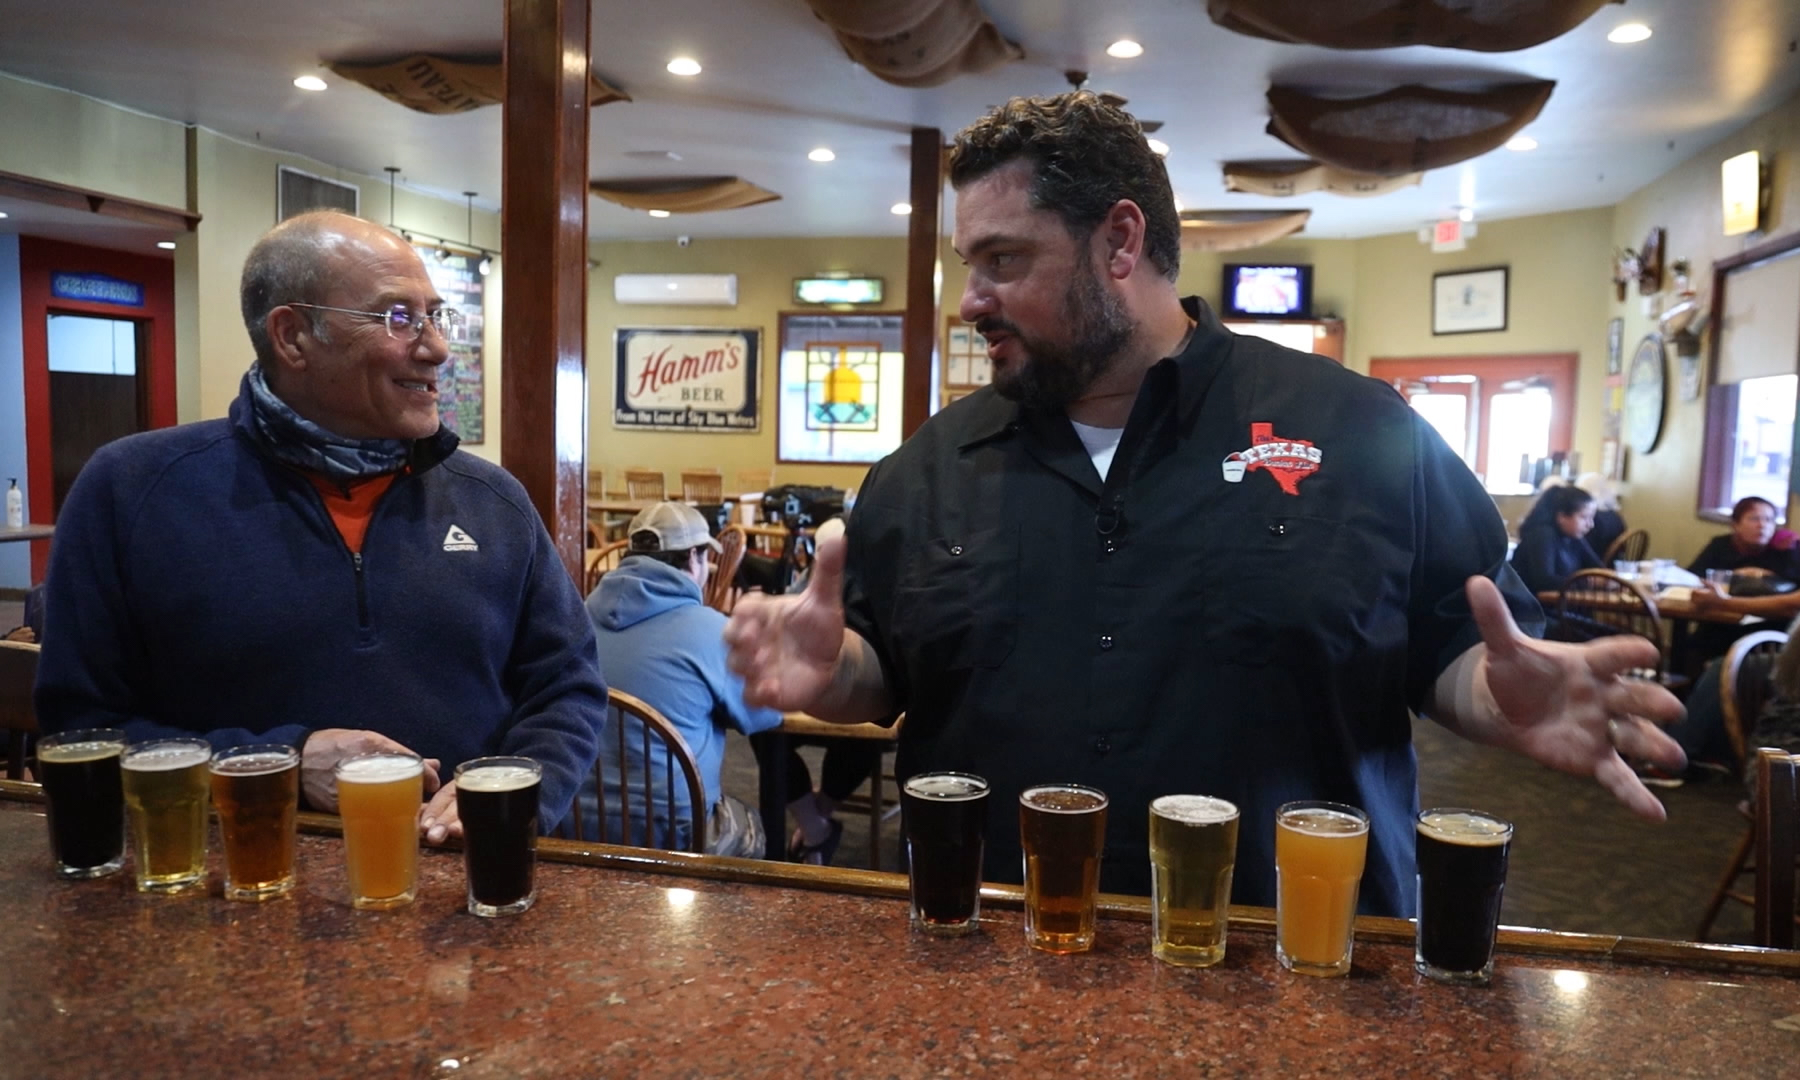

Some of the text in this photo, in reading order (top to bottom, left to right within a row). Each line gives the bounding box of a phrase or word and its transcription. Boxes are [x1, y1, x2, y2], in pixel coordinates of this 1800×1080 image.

[629, 342, 740, 398] Hamm's
[681, 387, 725, 401] BEER
[616, 409, 637, 422] From
[638, 410, 650, 423] the
[654, 410, 675, 424] Land
[676, 411, 686, 424] of
[688, 411, 704, 427] Sky
[706, 411, 726, 425] Blue
[1240, 442, 1322, 464] TEXAS
